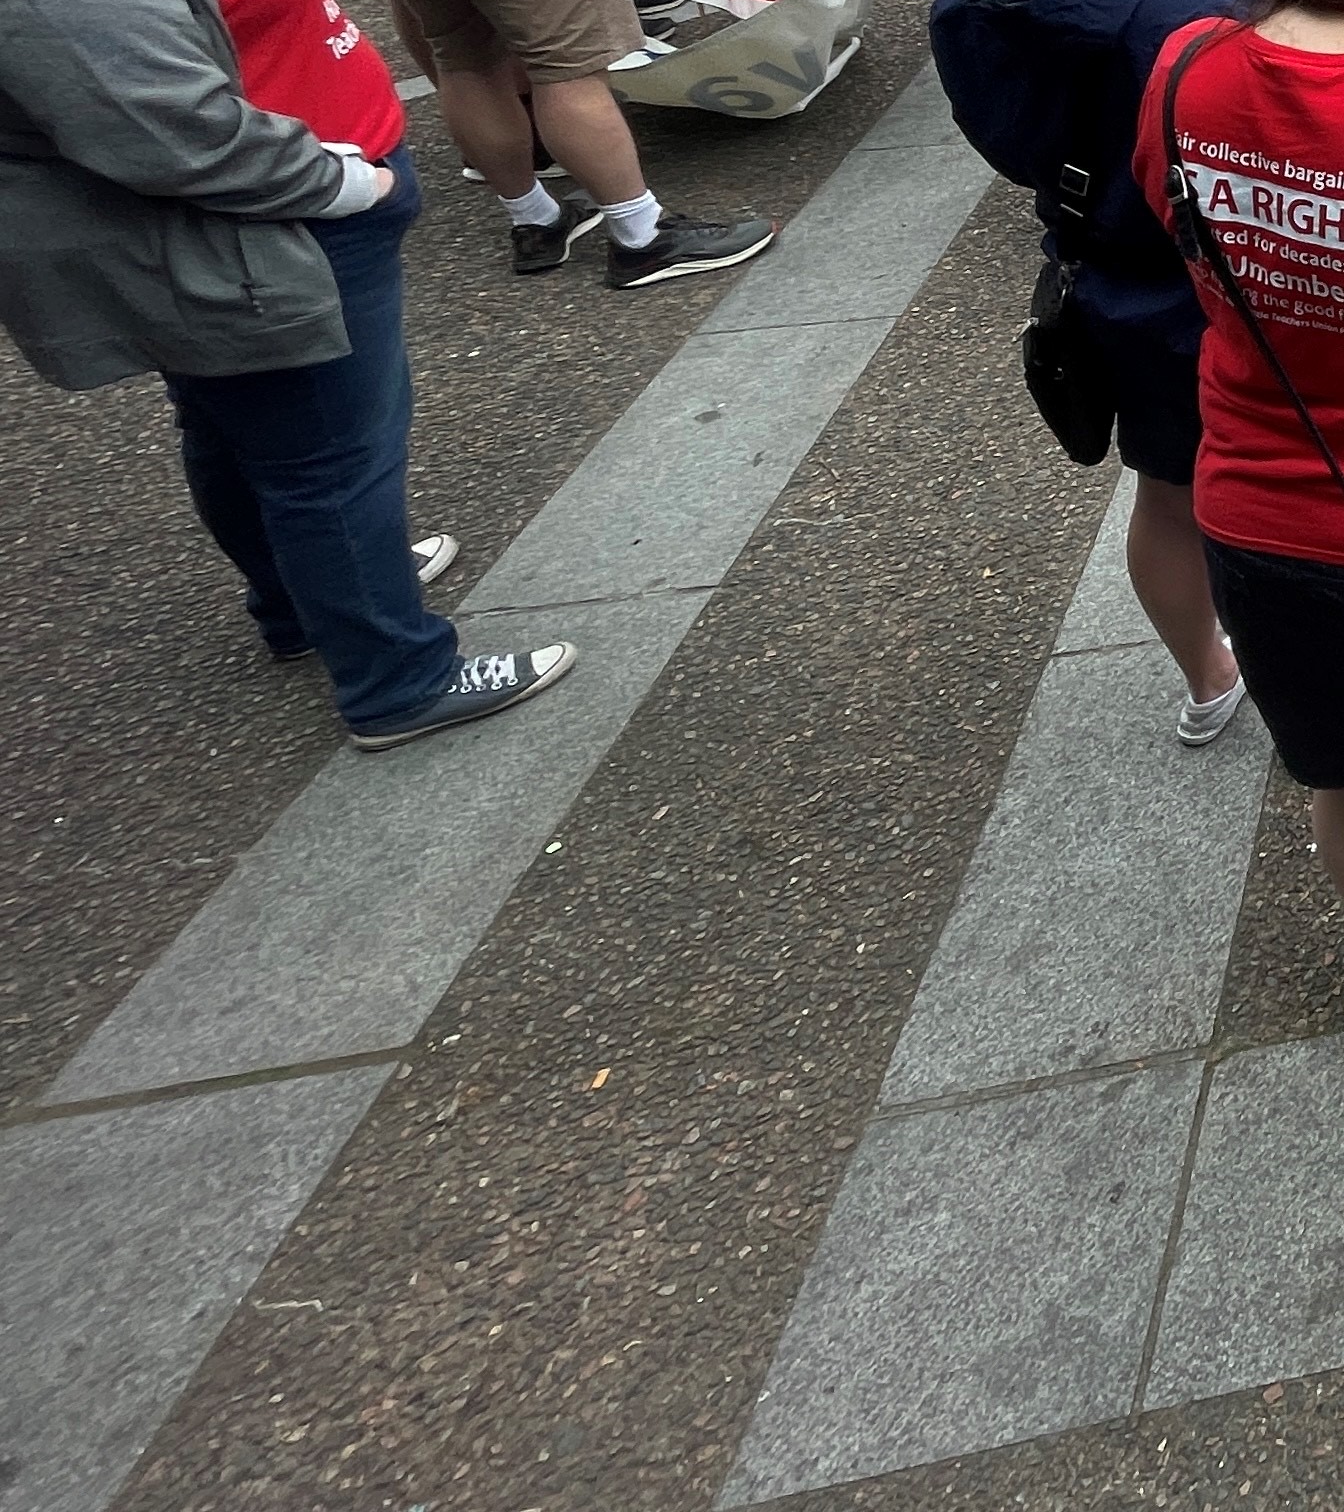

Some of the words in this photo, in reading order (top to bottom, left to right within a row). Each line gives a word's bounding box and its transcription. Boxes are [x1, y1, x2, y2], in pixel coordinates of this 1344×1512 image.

[1174, 128, 1197, 152] air
[1199, 141, 1280, 175] collective
[1208, 178, 1240, 215] A
[1253, 232, 1276, 255] for
[1263, 294, 1290, 309] the
[1293, 299, 1335, 319] good
